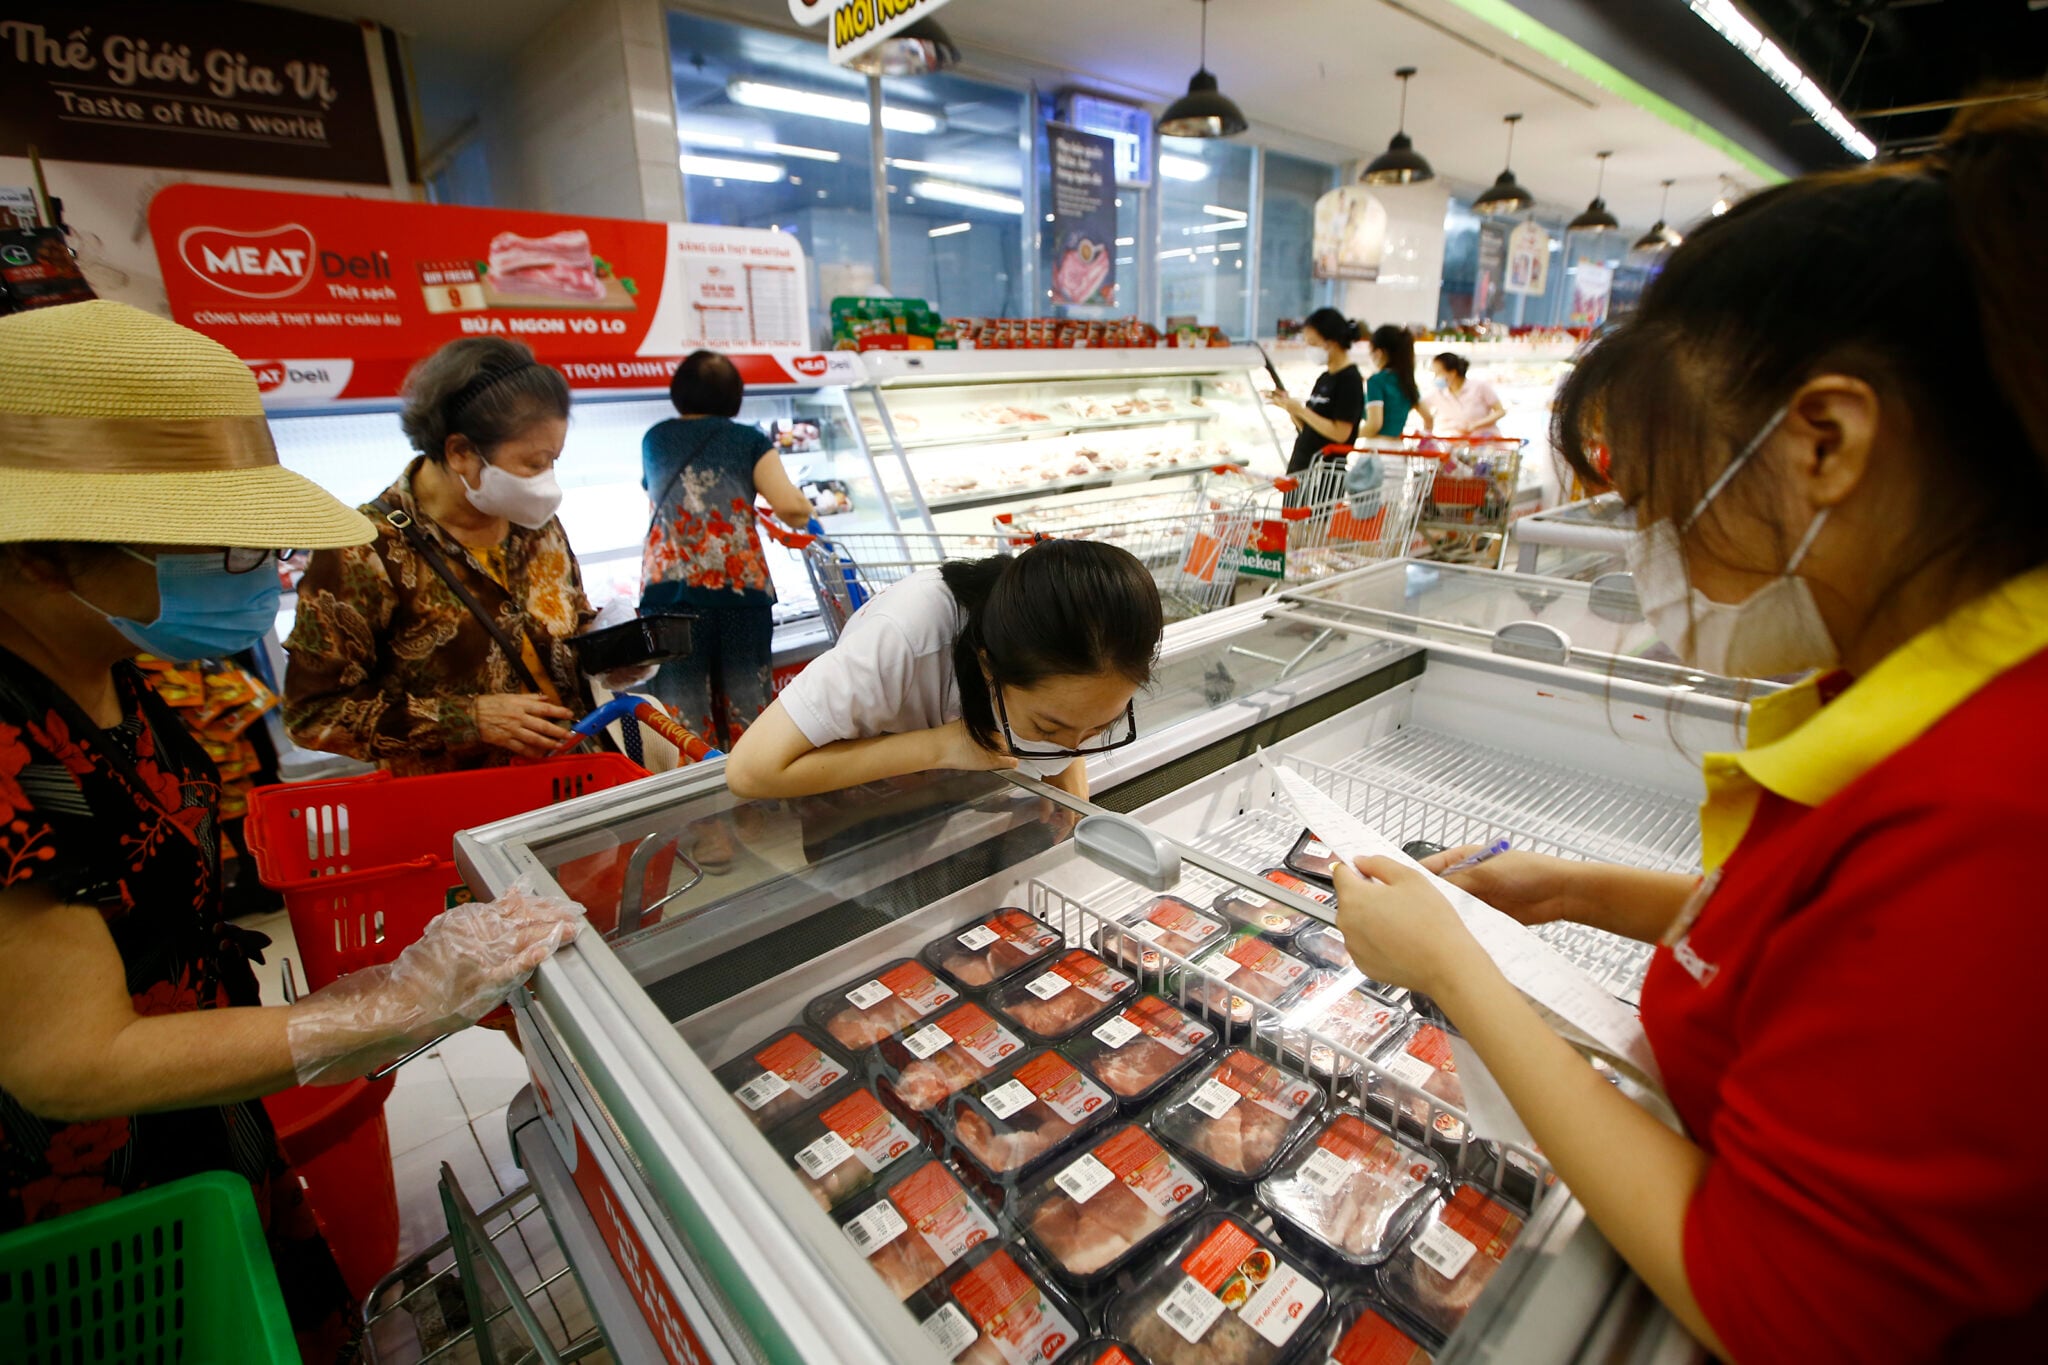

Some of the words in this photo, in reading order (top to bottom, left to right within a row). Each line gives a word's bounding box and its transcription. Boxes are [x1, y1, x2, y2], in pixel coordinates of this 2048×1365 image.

[2, 20, 96, 70] Thế
[103, 34, 199, 86] Giới
[204, 49, 283, 98] Gia
[286, 60, 338, 110] Vị
[54, 90, 144, 120] Taste
[153, 101, 185, 126] of
[195, 105, 240, 132] the
[248, 114, 326, 140] world
[201, 245, 306, 277] MEAT
[320, 250, 391, 279] Deli
[509, 317, 566, 333] NGON
[601, 318, 626, 334] LO
[257, 368, 281, 383] AT
[288, 367, 330, 384] Deli
[562, 363, 616, 382] TRỌN
[618, 361, 664, 378] DINH
